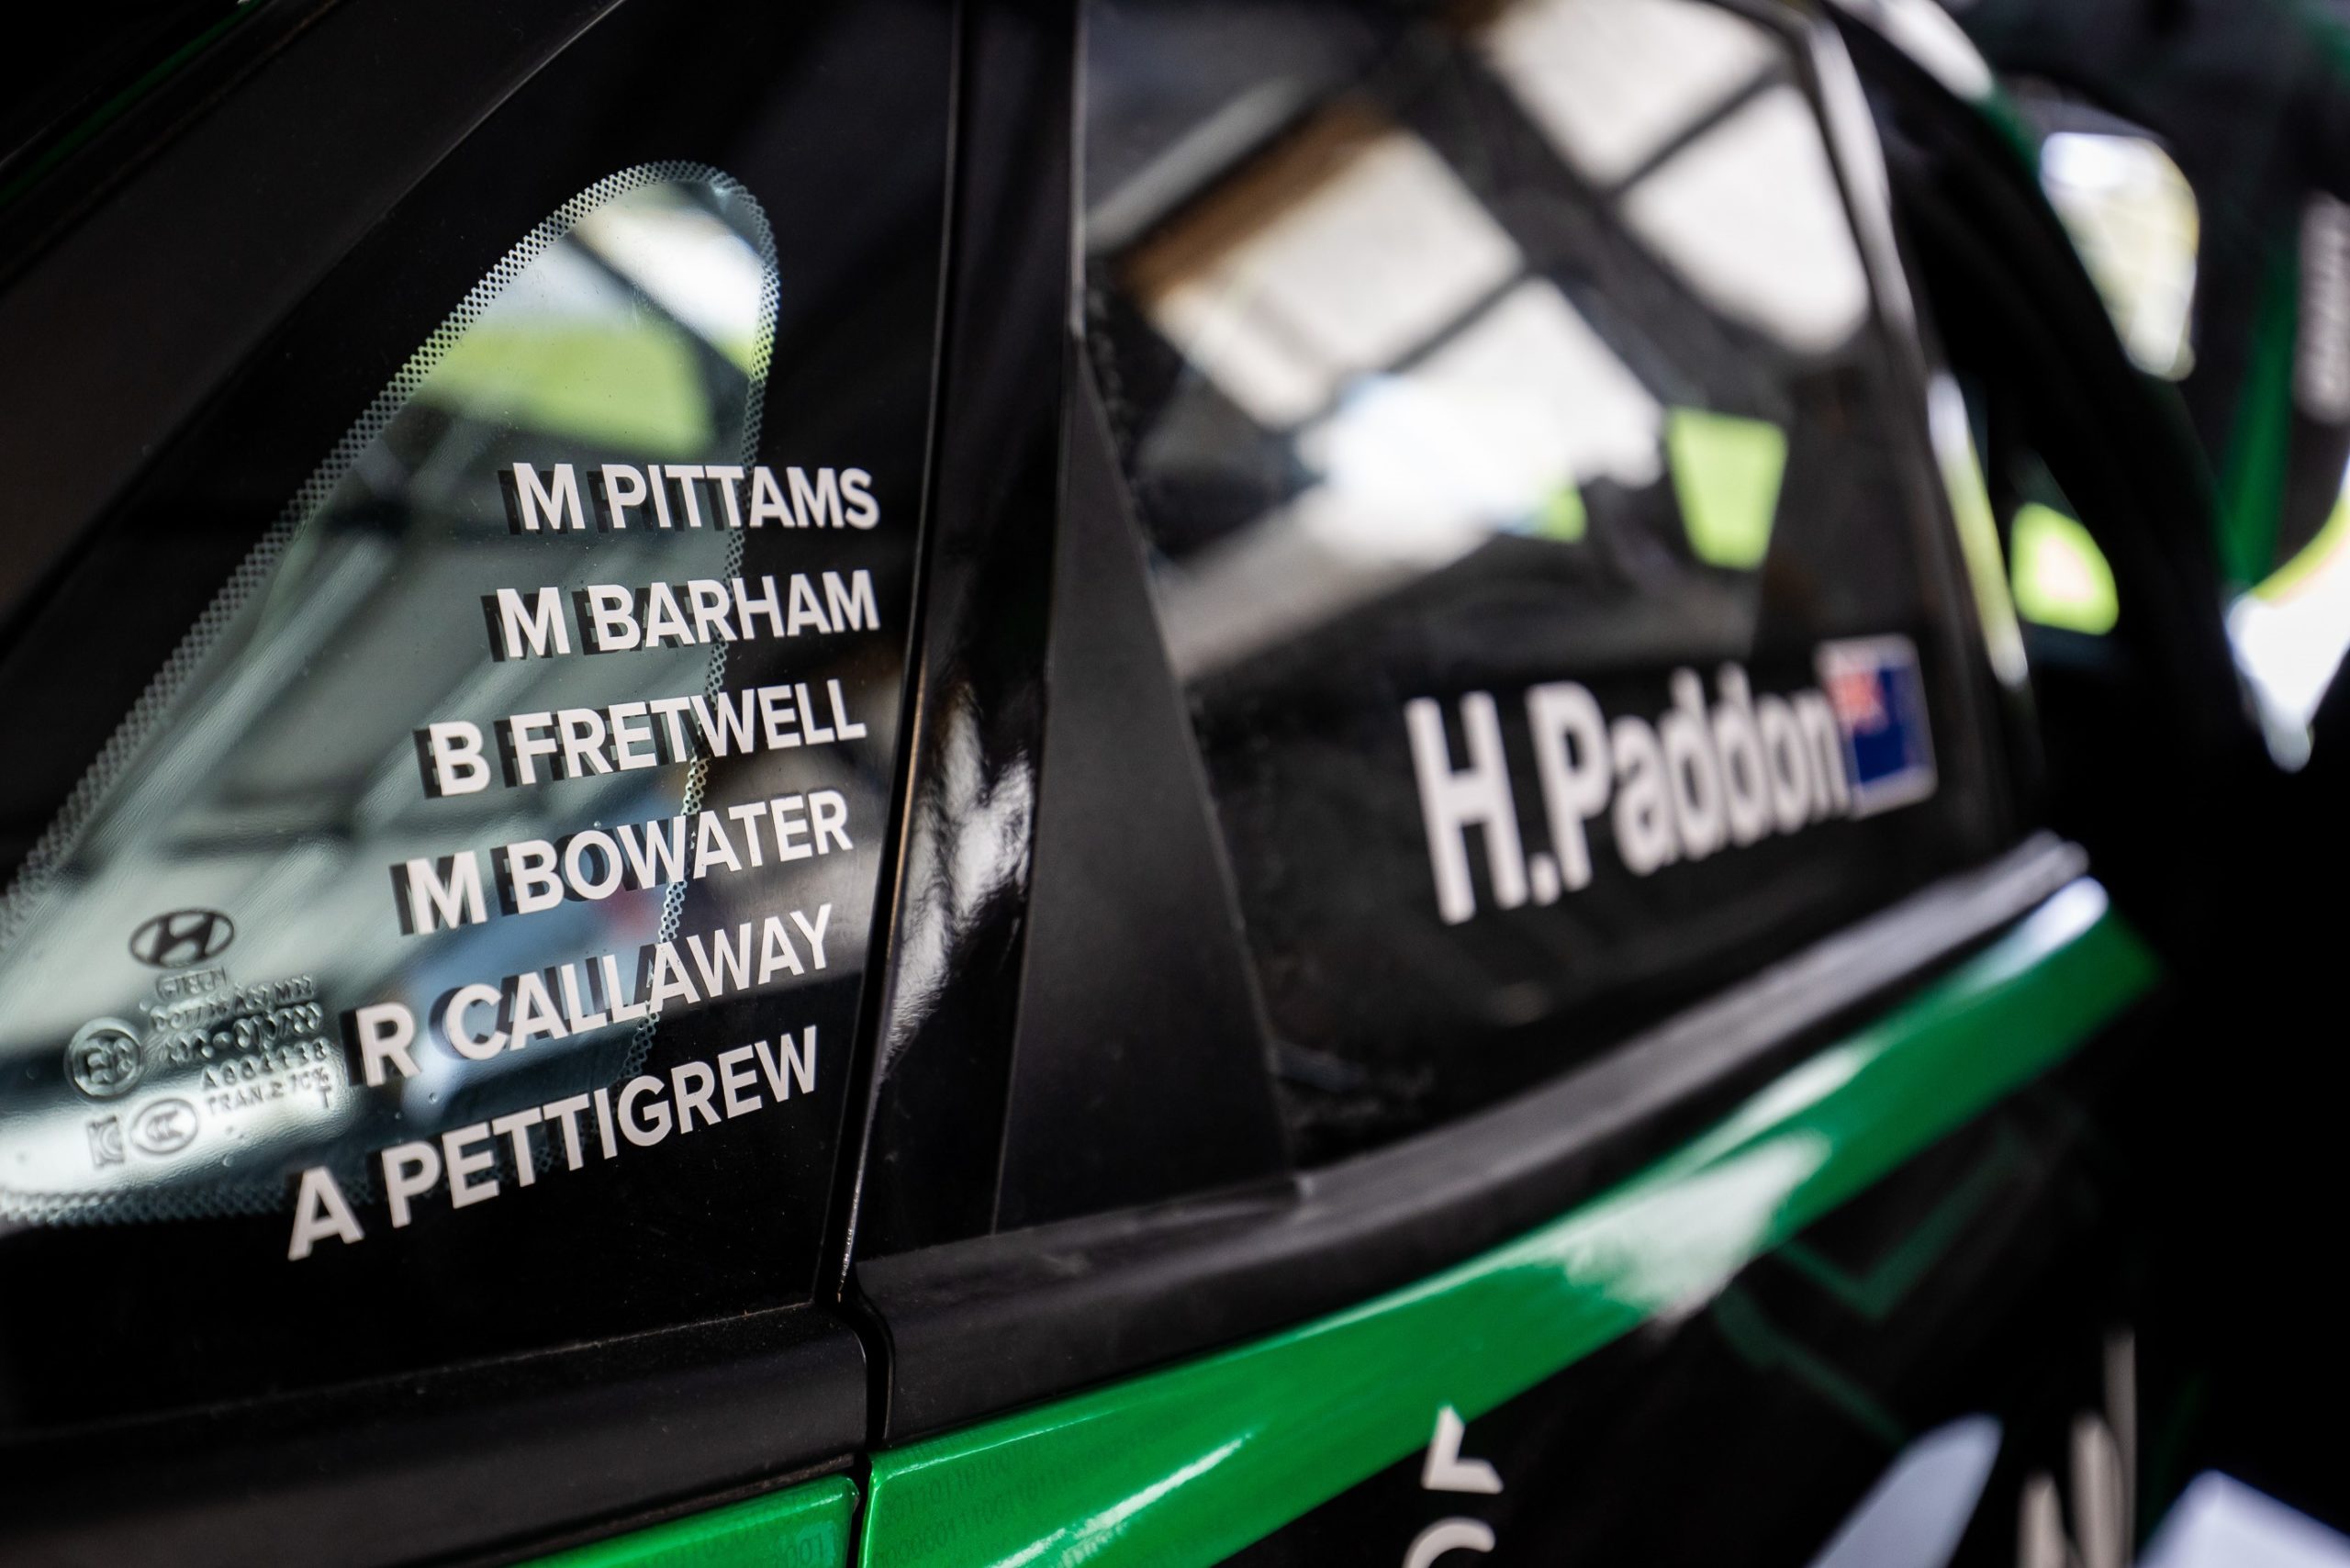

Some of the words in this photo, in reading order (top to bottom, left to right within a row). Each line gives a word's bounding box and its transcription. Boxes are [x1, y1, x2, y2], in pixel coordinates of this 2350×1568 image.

[513, 462, 585, 530] M
[600, 464, 880, 530] PITTAMS
[497, 587, 570, 657] M
[588, 570, 879, 652] BARHAM
[429, 721, 491, 796] B
[509, 679, 866, 785] FRETWELL
[1404, 660, 1853, 925] H.Paddon
[408, 851, 487, 935] M
[508, 790, 854, 915] BOWATER
[355, 1002, 422, 1088] R
[446, 903, 833, 1061] CALLAWAY
[287, 1166, 364, 1261] A
[381, 1025, 817, 1229] PETTIGREW
